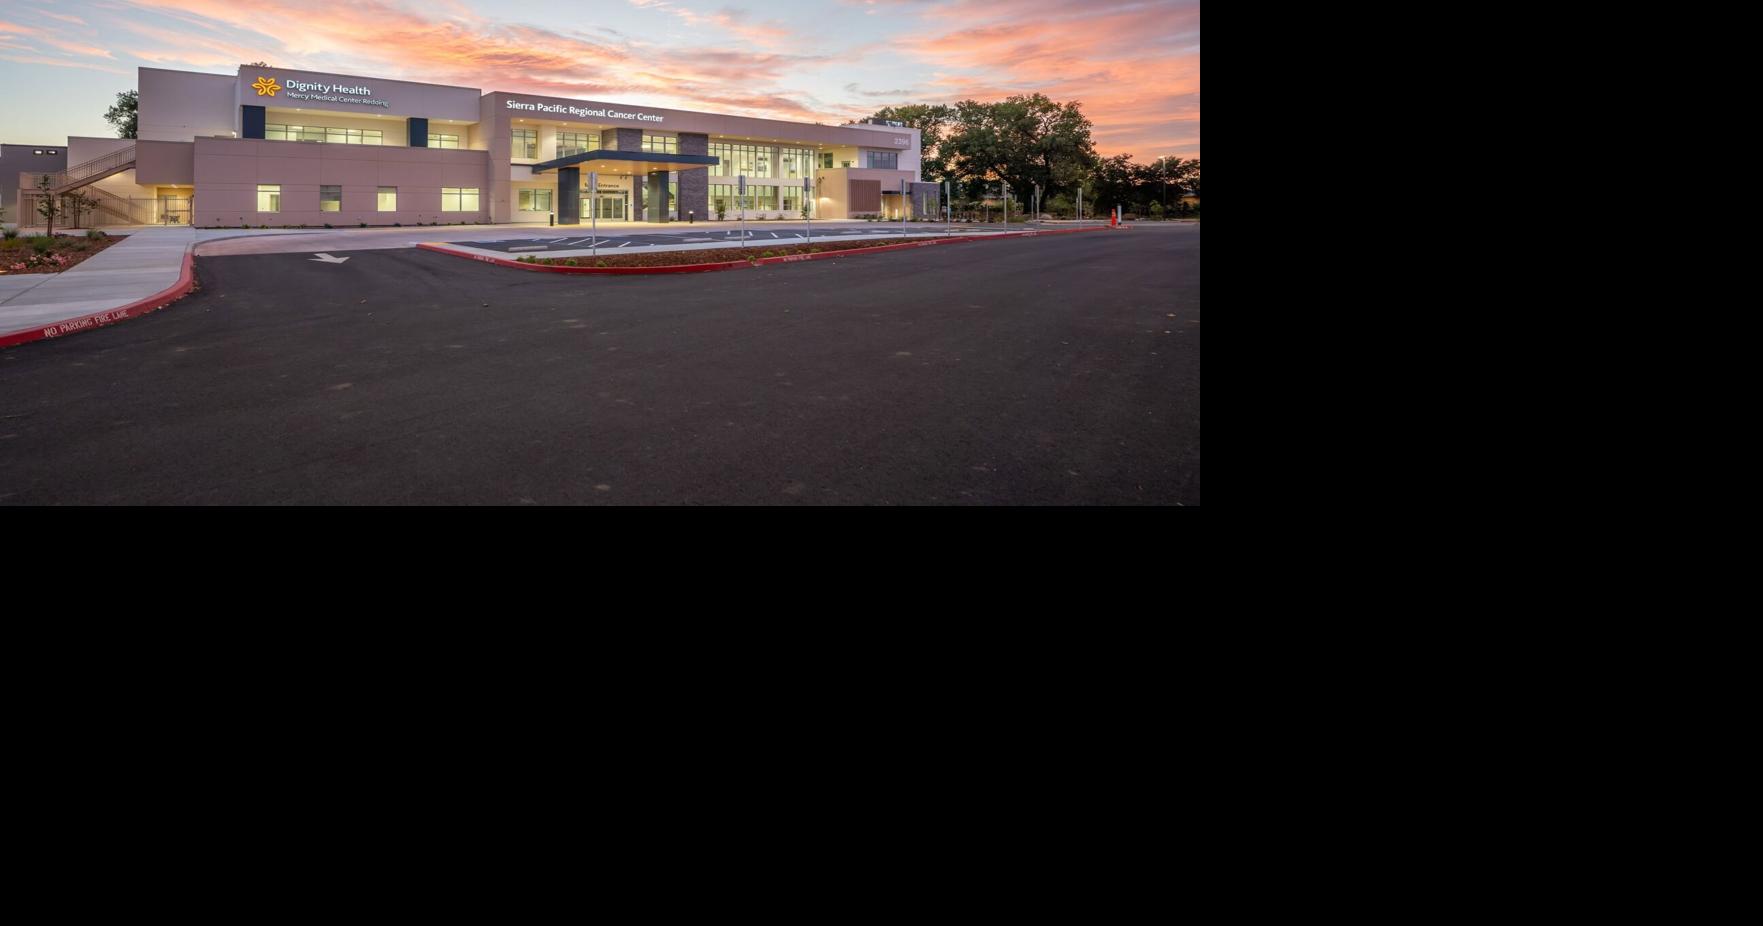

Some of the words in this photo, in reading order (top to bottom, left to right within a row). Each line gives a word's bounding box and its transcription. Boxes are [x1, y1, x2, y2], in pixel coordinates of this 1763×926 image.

[286, 80, 330, 94] Dignity
[333, 84, 371, 96] Health
[287, 92, 309, 100] Mercy
[311, 93, 338, 102] Medical
[339, 96, 362, 104] Center
[506, 100, 535, 111] Sierra
[537, 103, 567, 114] Pacific
[569, 106, 605, 118] Regional
[607, 110, 636, 120] Cancer
[637, 112, 664, 122] Center
[43, 327, 58, 338] NO
[60, 318, 93, 333] PARKING
[94, 313, 112, 325] FIRE
